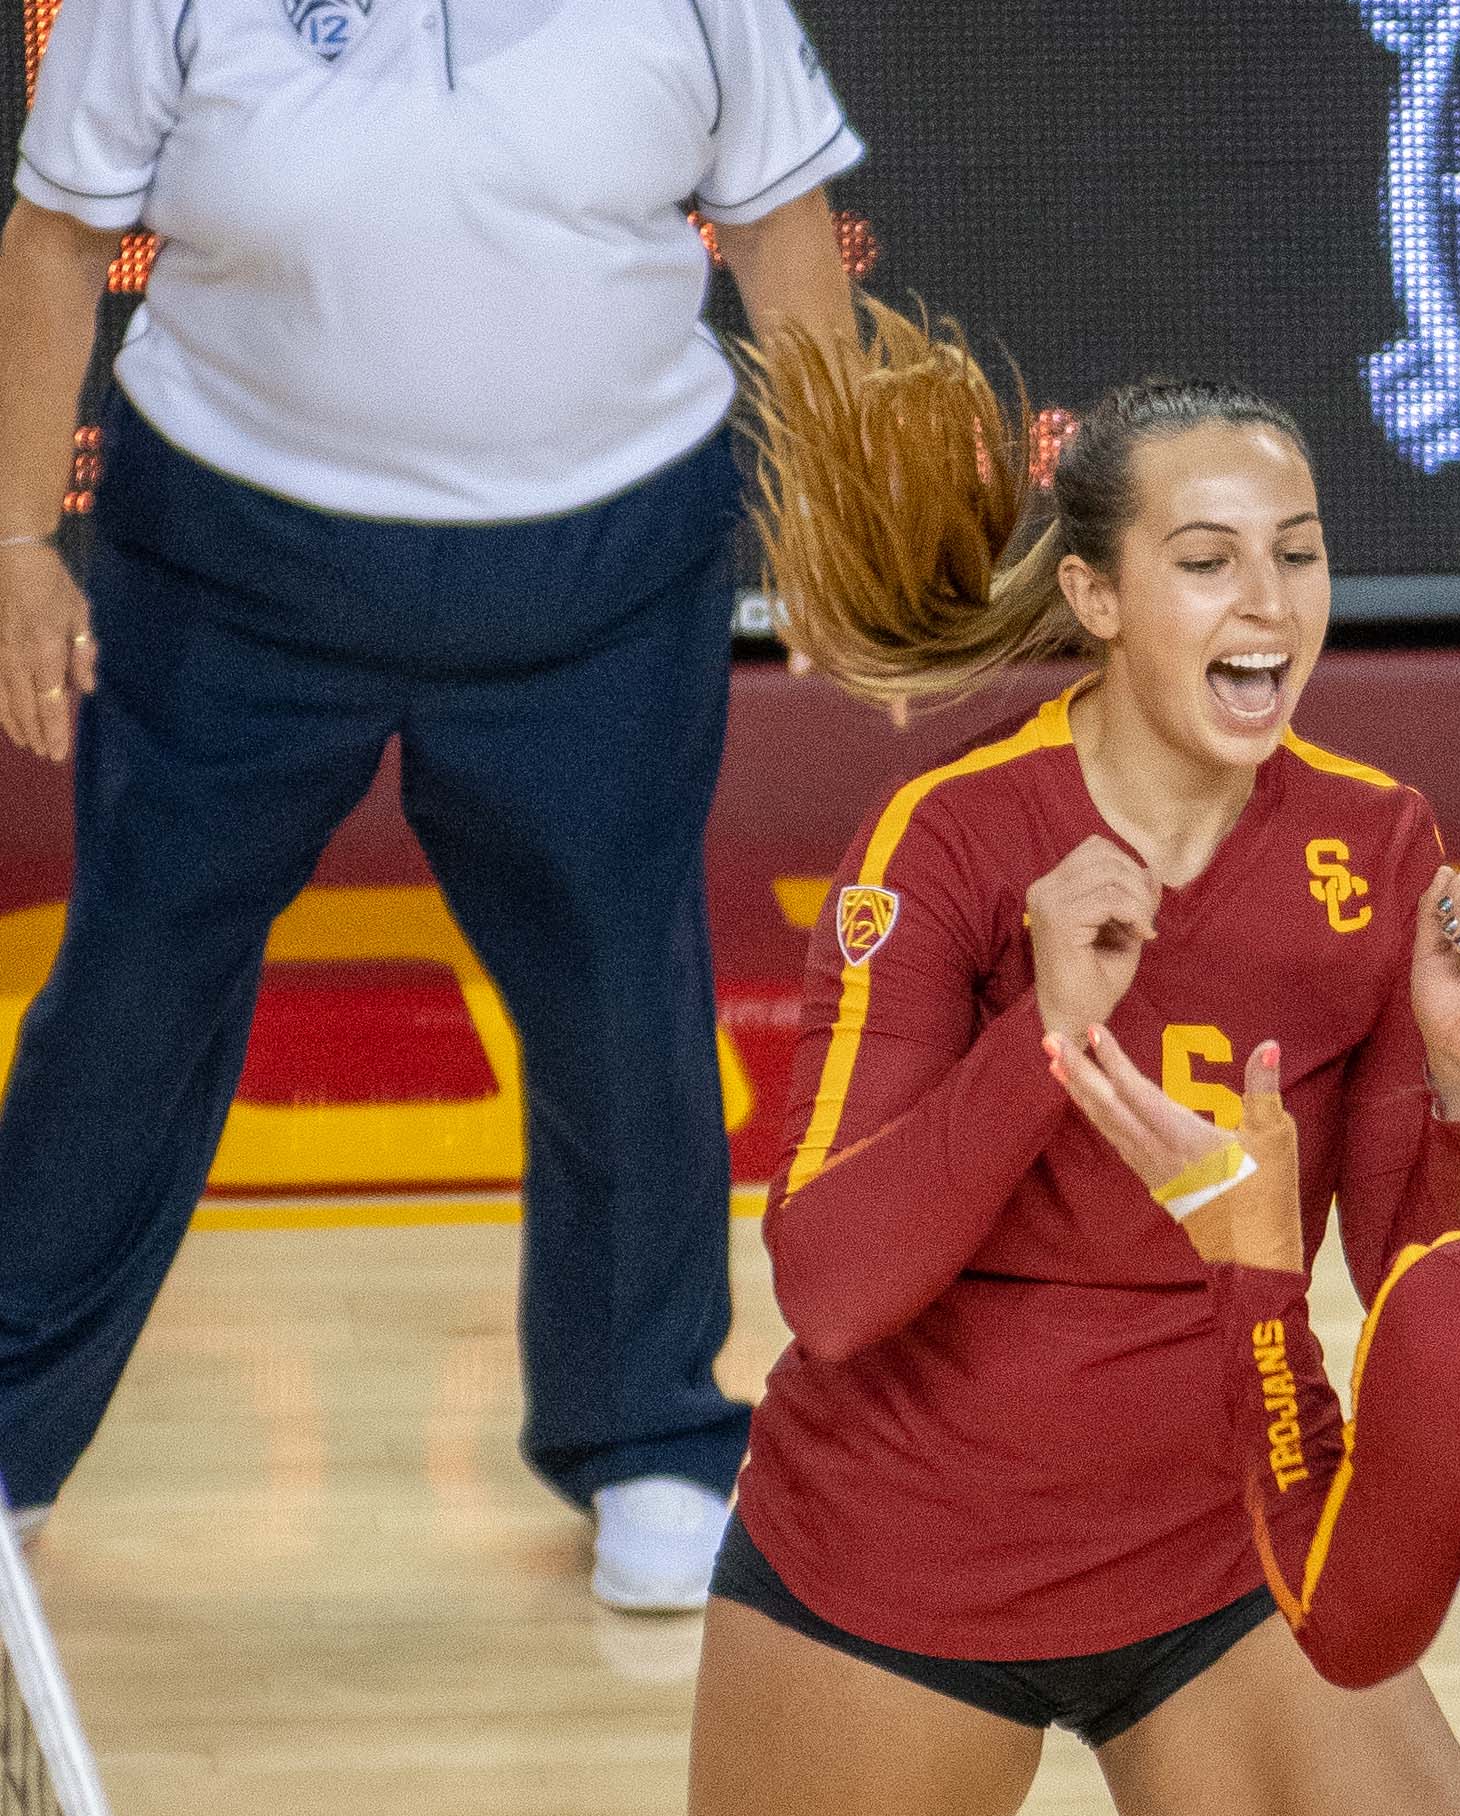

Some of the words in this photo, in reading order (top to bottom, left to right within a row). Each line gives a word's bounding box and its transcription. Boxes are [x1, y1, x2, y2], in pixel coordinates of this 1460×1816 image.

[310, 15, 348, 44] 12
[1305, 838, 1373, 934] SC
[846, 920, 876, 949] 12
[1162, 1024, 1244, 1131] 6
[1252, 1319, 1309, 1493] TROJANS
